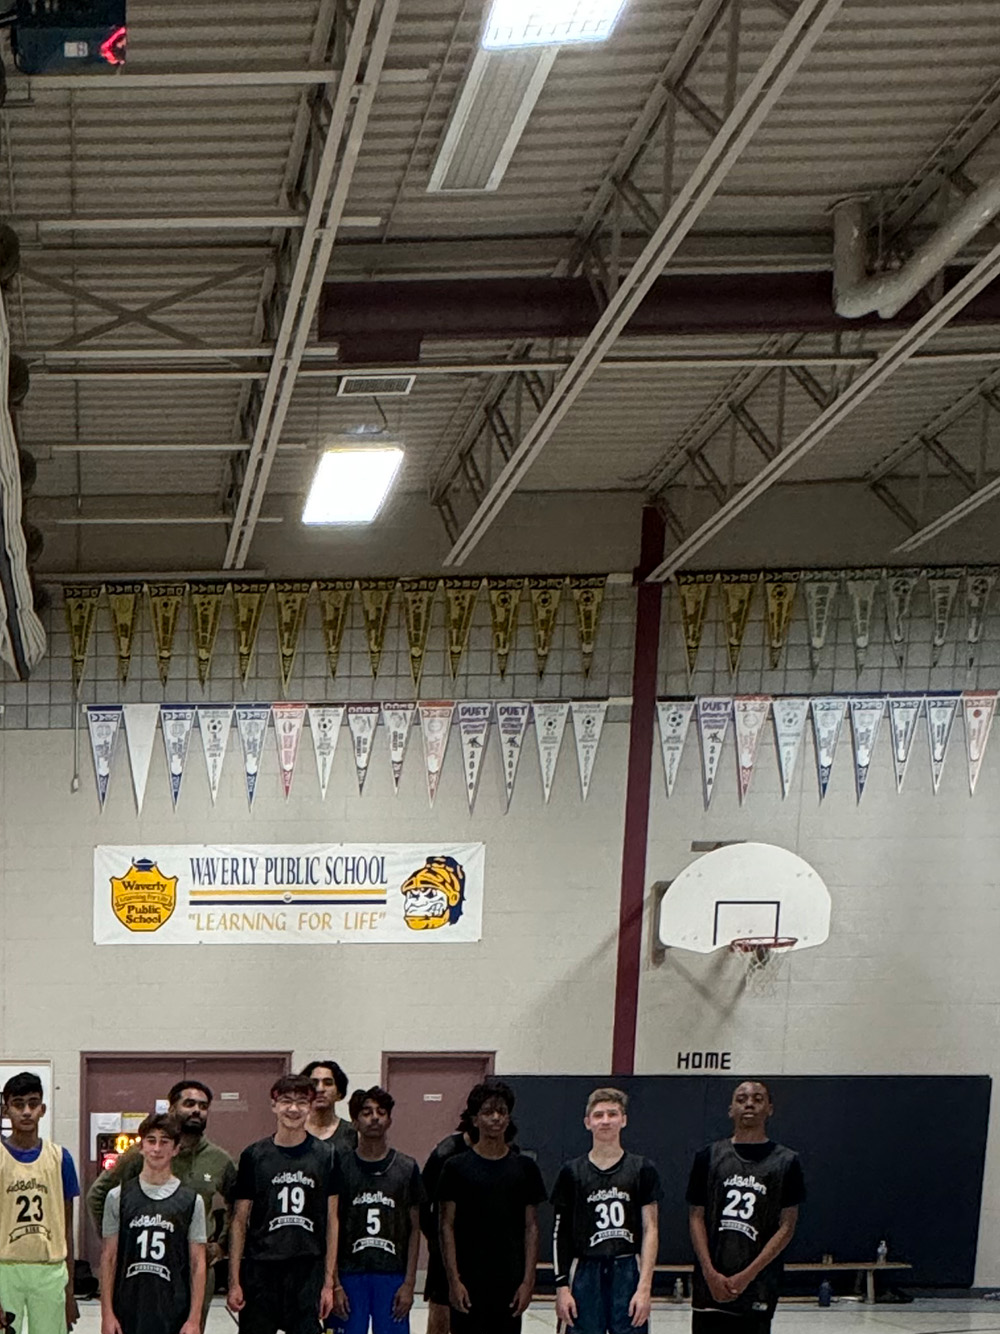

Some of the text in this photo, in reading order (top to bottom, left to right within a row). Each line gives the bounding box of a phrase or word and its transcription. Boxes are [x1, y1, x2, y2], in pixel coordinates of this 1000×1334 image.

[461, 706, 488, 716] DUET
[500, 706, 527, 716] DUET
[702, 702, 730, 711] DUET
[189, 856, 388, 885] WAVERLY PUBLIC SCHOOL
[122, 880, 167, 892] Waverly
[127, 905, 161, 914] Public
[126, 914, 161, 924] School
[299, 912, 332, 930] FOR
[677, 1052, 731, 1070] HOME
[16, 1195, 43, 1223] 23
[277, 1186, 305, 1214] 19
[722, 1189, 756, 1220] 23
[366, 1208, 381, 1235] 5
[595, 1201, 625, 1229] 30
[136, 1230, 165, 1260] 15
